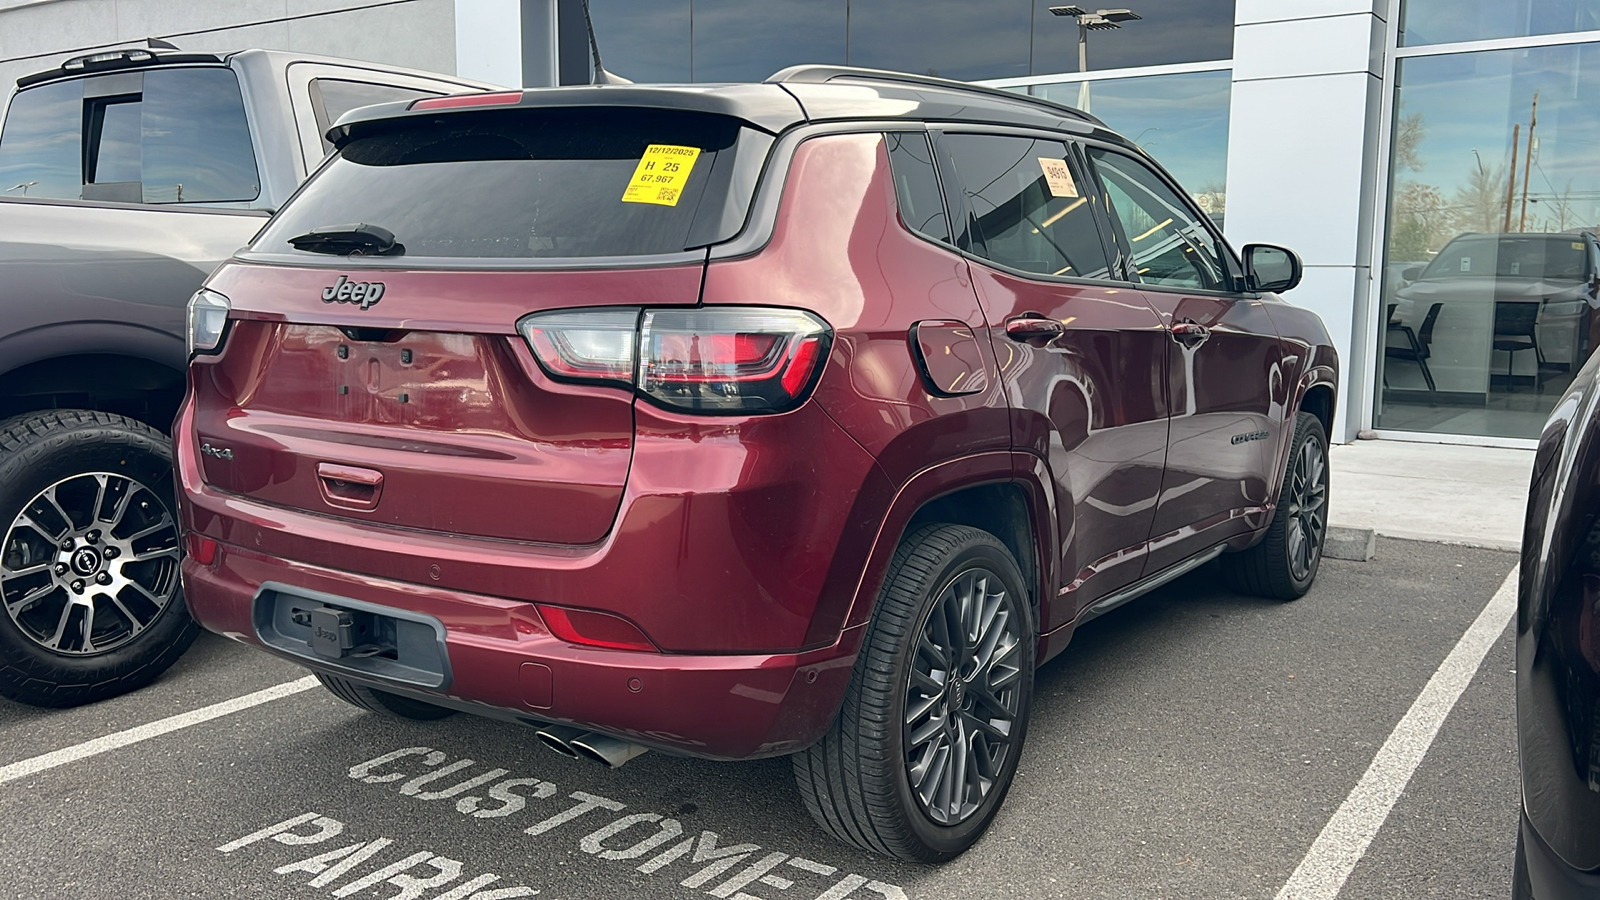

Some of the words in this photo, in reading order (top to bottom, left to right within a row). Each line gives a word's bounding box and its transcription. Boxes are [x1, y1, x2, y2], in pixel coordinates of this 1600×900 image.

[648, 147, 694, 157] 12/12/2025
[644, 161, 655, 171] H
[662, 162, 680, 173] 25
[640, 174, 674, 184] 67,967
[322, 275, 386, 310] Jeep
[314, 626, 337, 643] Jeep
